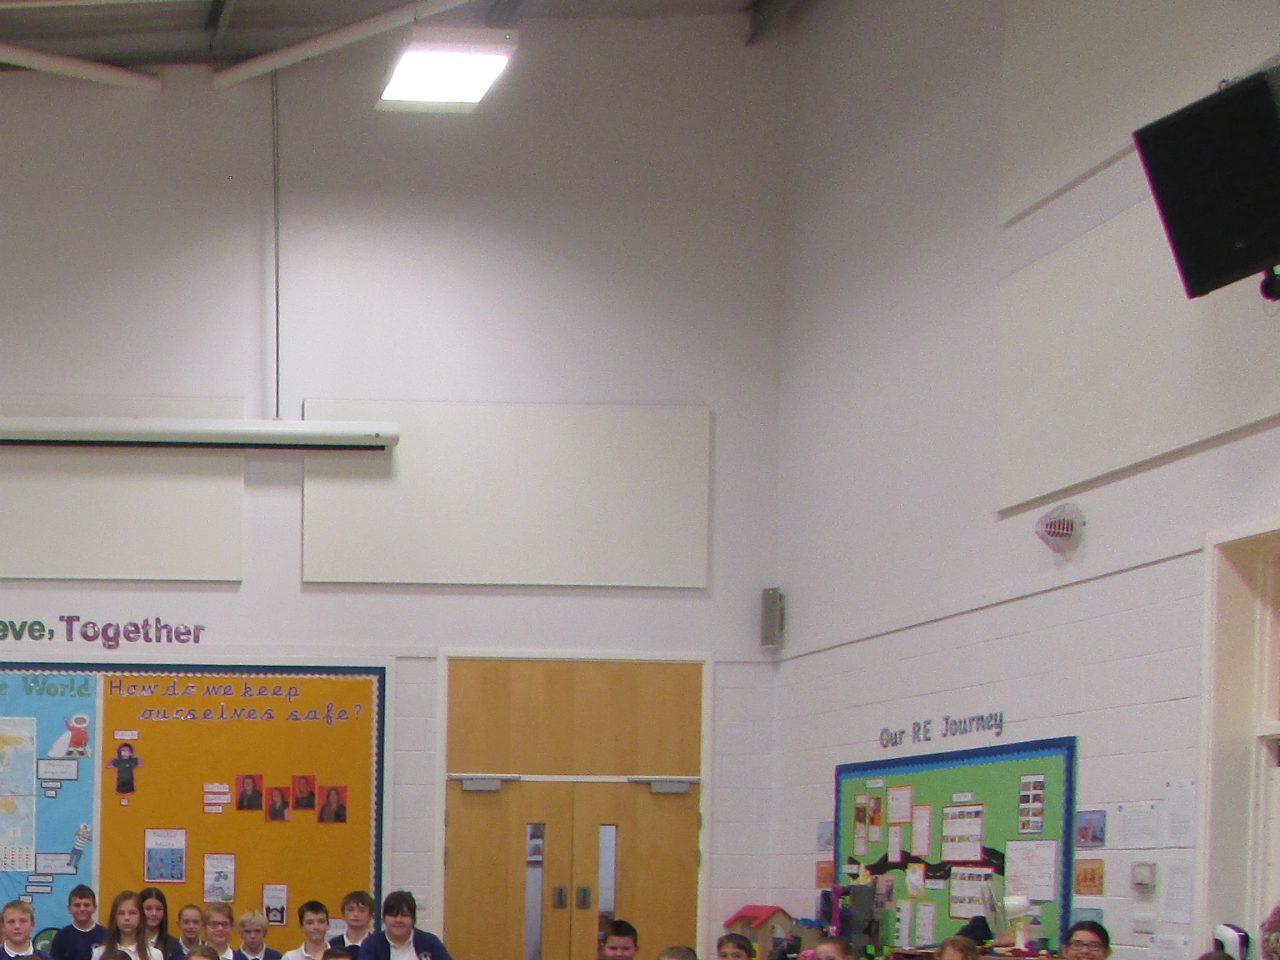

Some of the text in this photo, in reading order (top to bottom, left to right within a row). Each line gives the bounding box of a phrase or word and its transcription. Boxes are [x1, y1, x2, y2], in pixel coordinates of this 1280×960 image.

[58, 615, 206, 650] Together
[22, 675, 91, 698] World
[109, 678, 301, 703] How do we keep
[137, 702, 363, 726] ourselves safe?
[880, 711, 1004, 748] Our RE Journey
